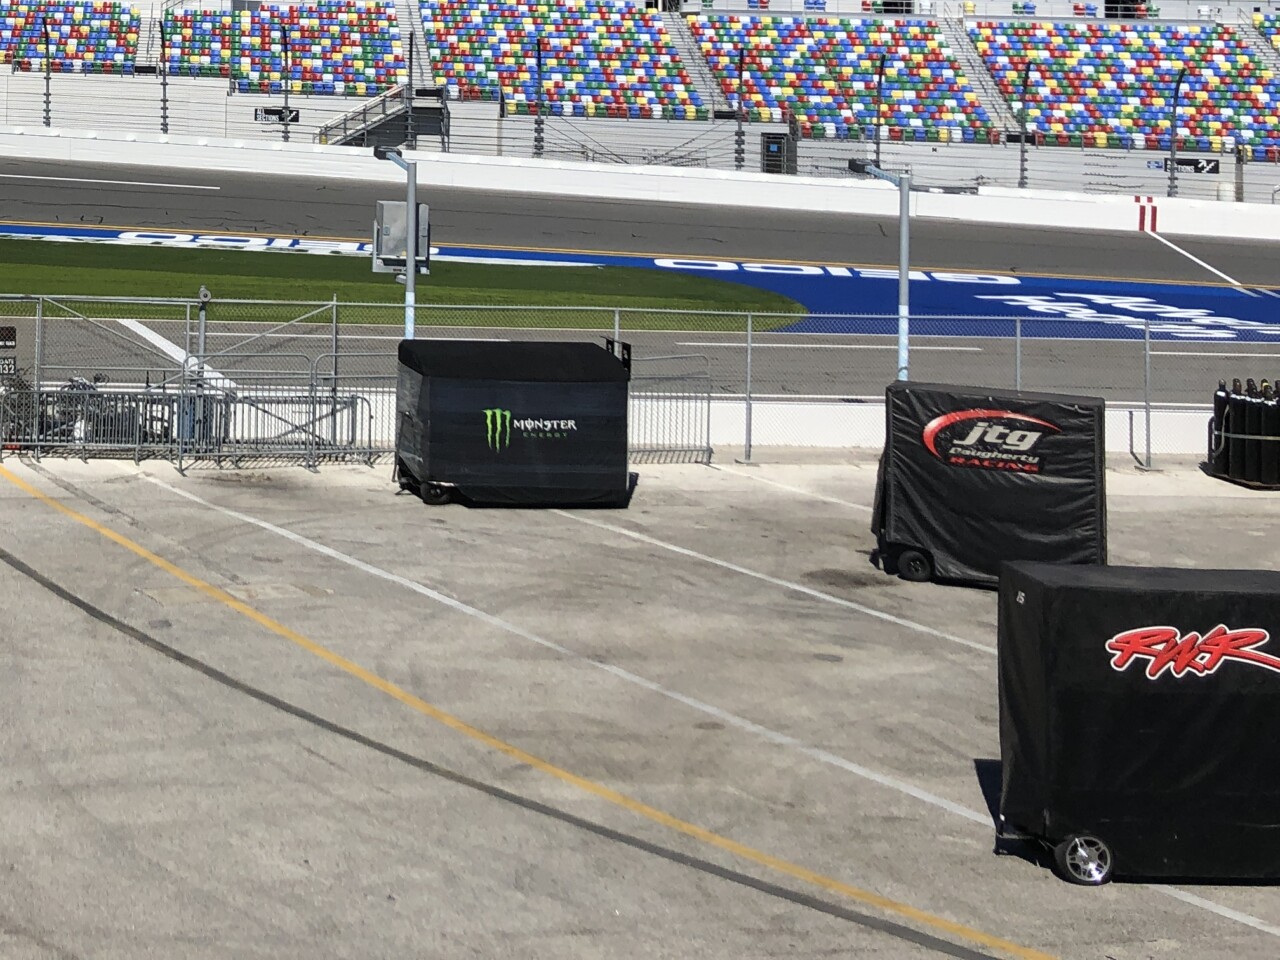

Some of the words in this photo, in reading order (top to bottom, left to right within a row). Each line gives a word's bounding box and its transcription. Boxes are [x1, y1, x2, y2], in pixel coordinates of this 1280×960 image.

[654, 258, 1022, 285] GEICO
[0, 365, 15, 374] 132
[513, 418, 577, 431] MONSTER
[952, 422, 1042, 451] jtg
[948, 447, 1040, 464] Daugherty
[950, 456, 1039, 473] RACING
